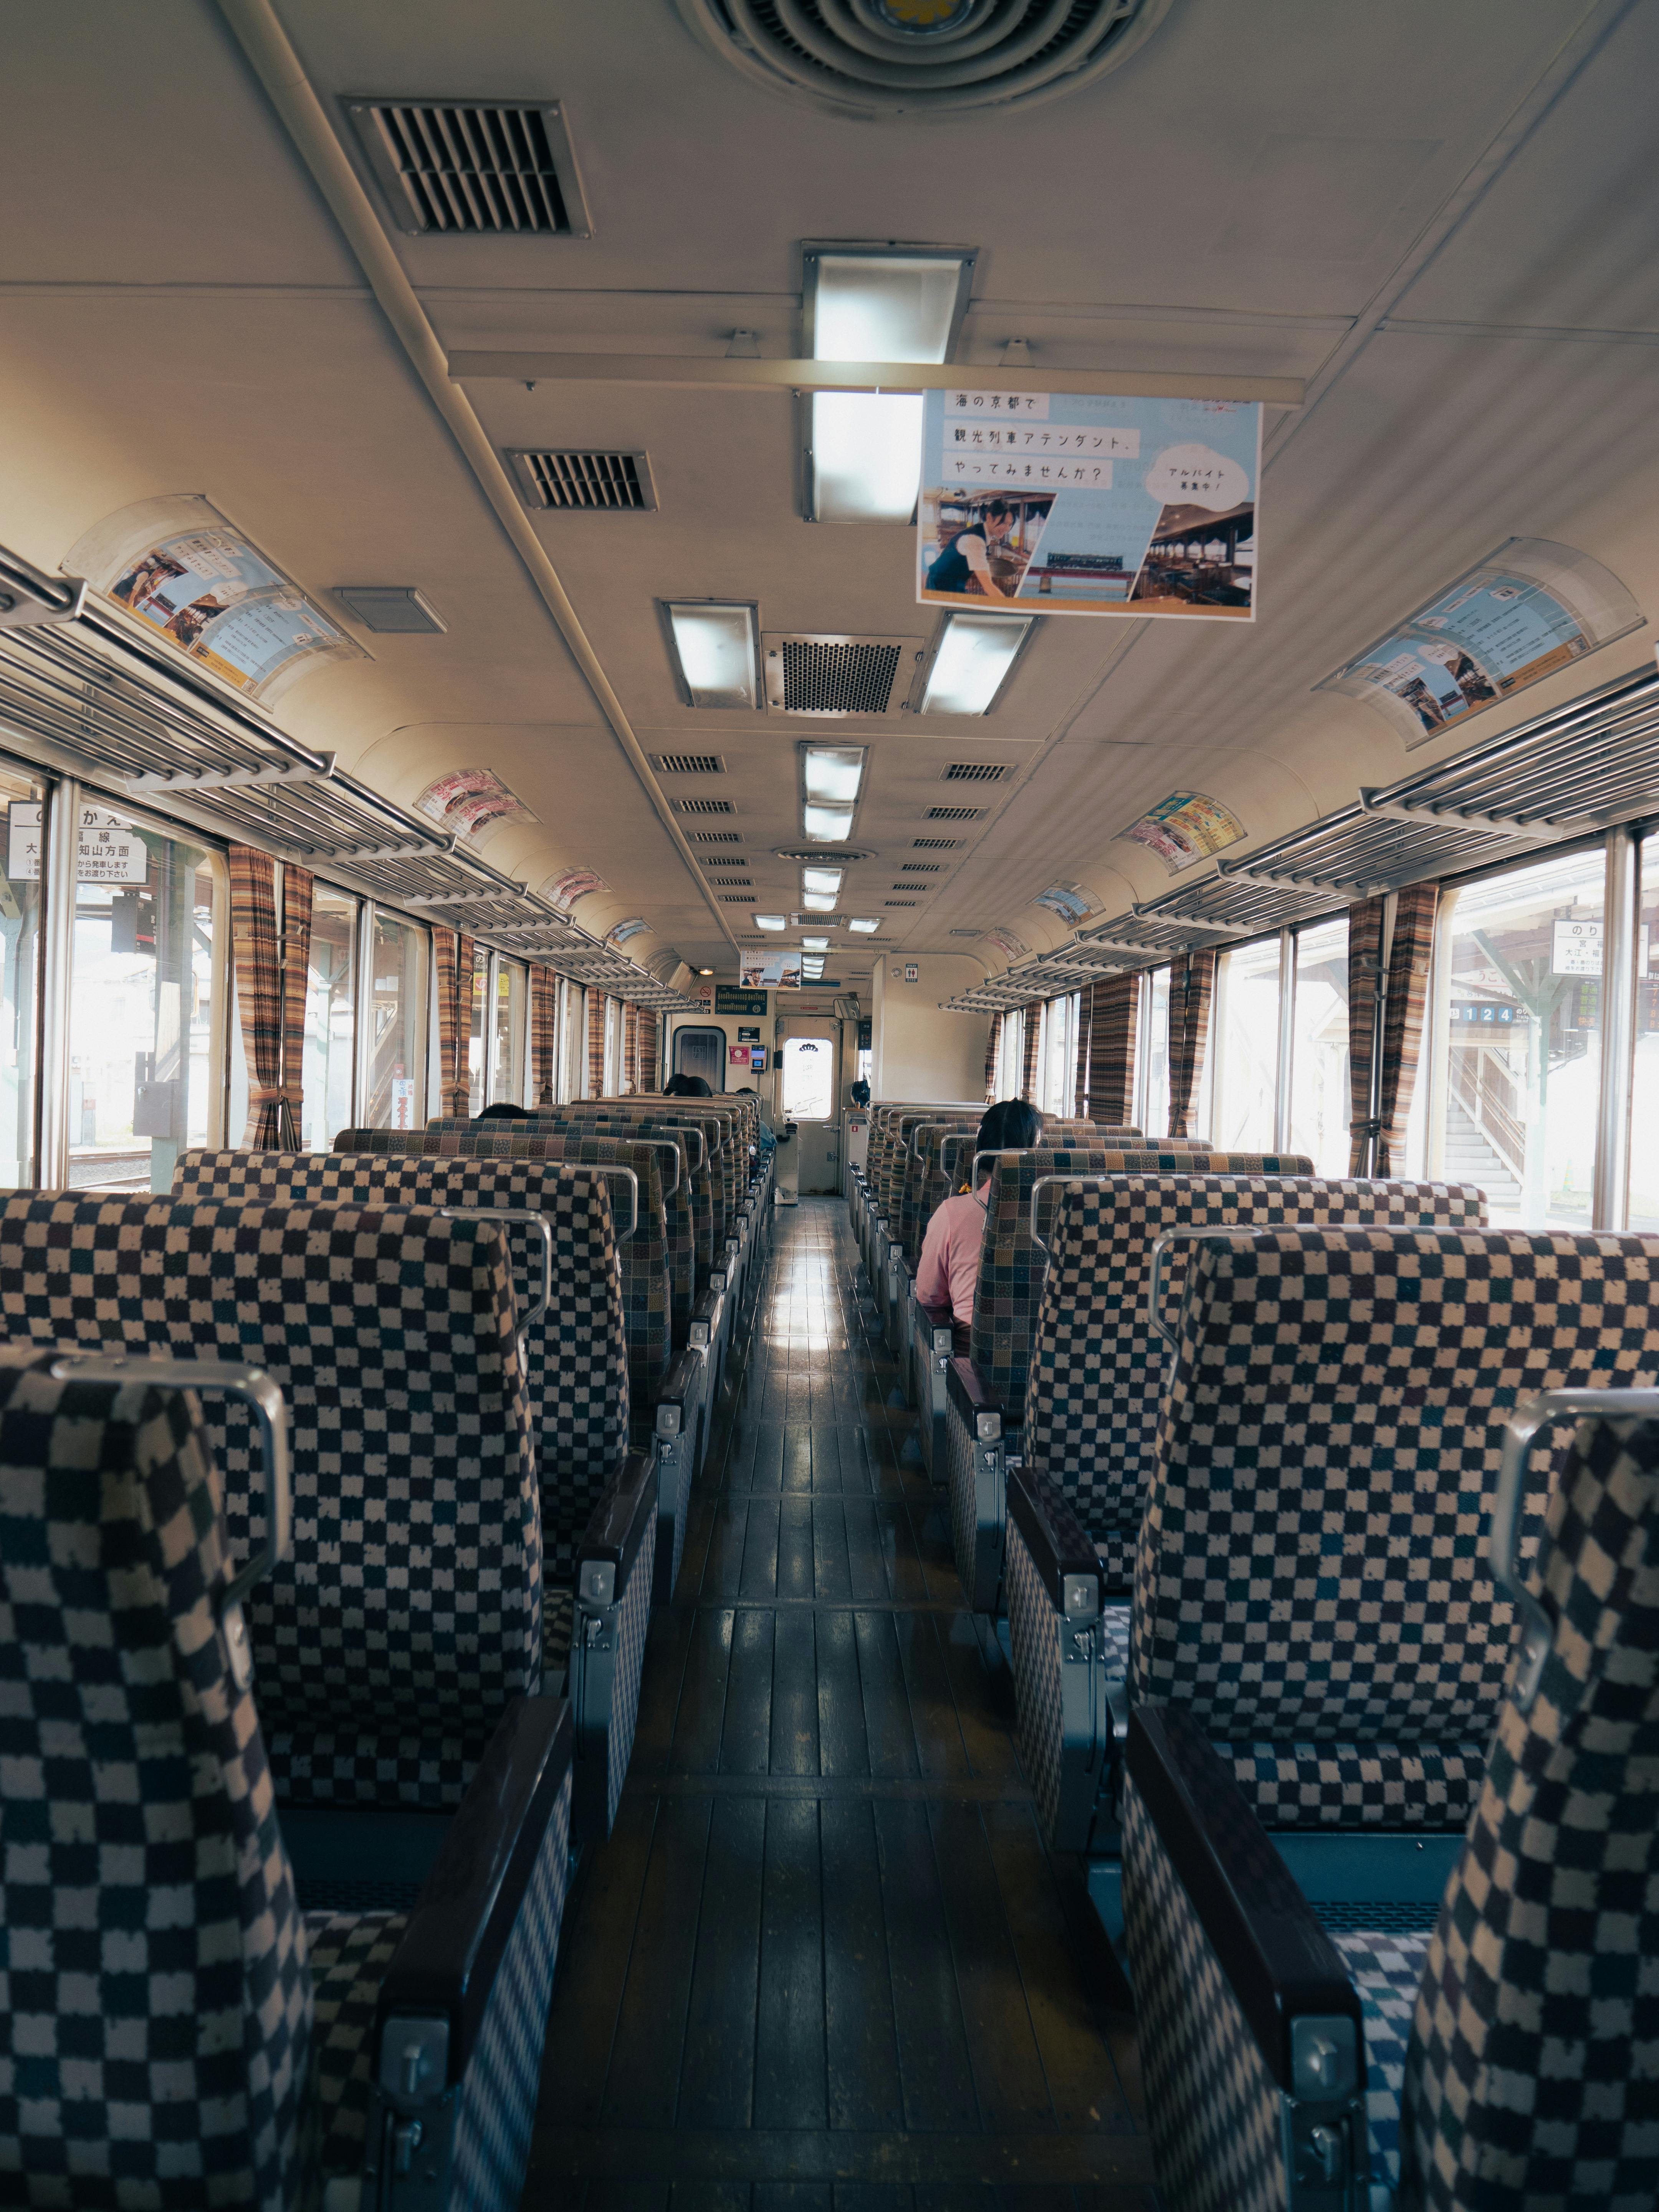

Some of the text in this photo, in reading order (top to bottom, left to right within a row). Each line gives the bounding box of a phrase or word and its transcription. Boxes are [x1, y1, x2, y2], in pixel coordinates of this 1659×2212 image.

[956, 394, 1036, 410] 海の京都で
[954, 428, 1130, 451] 観光列車アテンダント。
[954, 461, 1101, 481] やってみませんか？
[1169, 468, 1225, 478] アルバイト
[1467, 1008, 1509, 1020] 1 2 4
